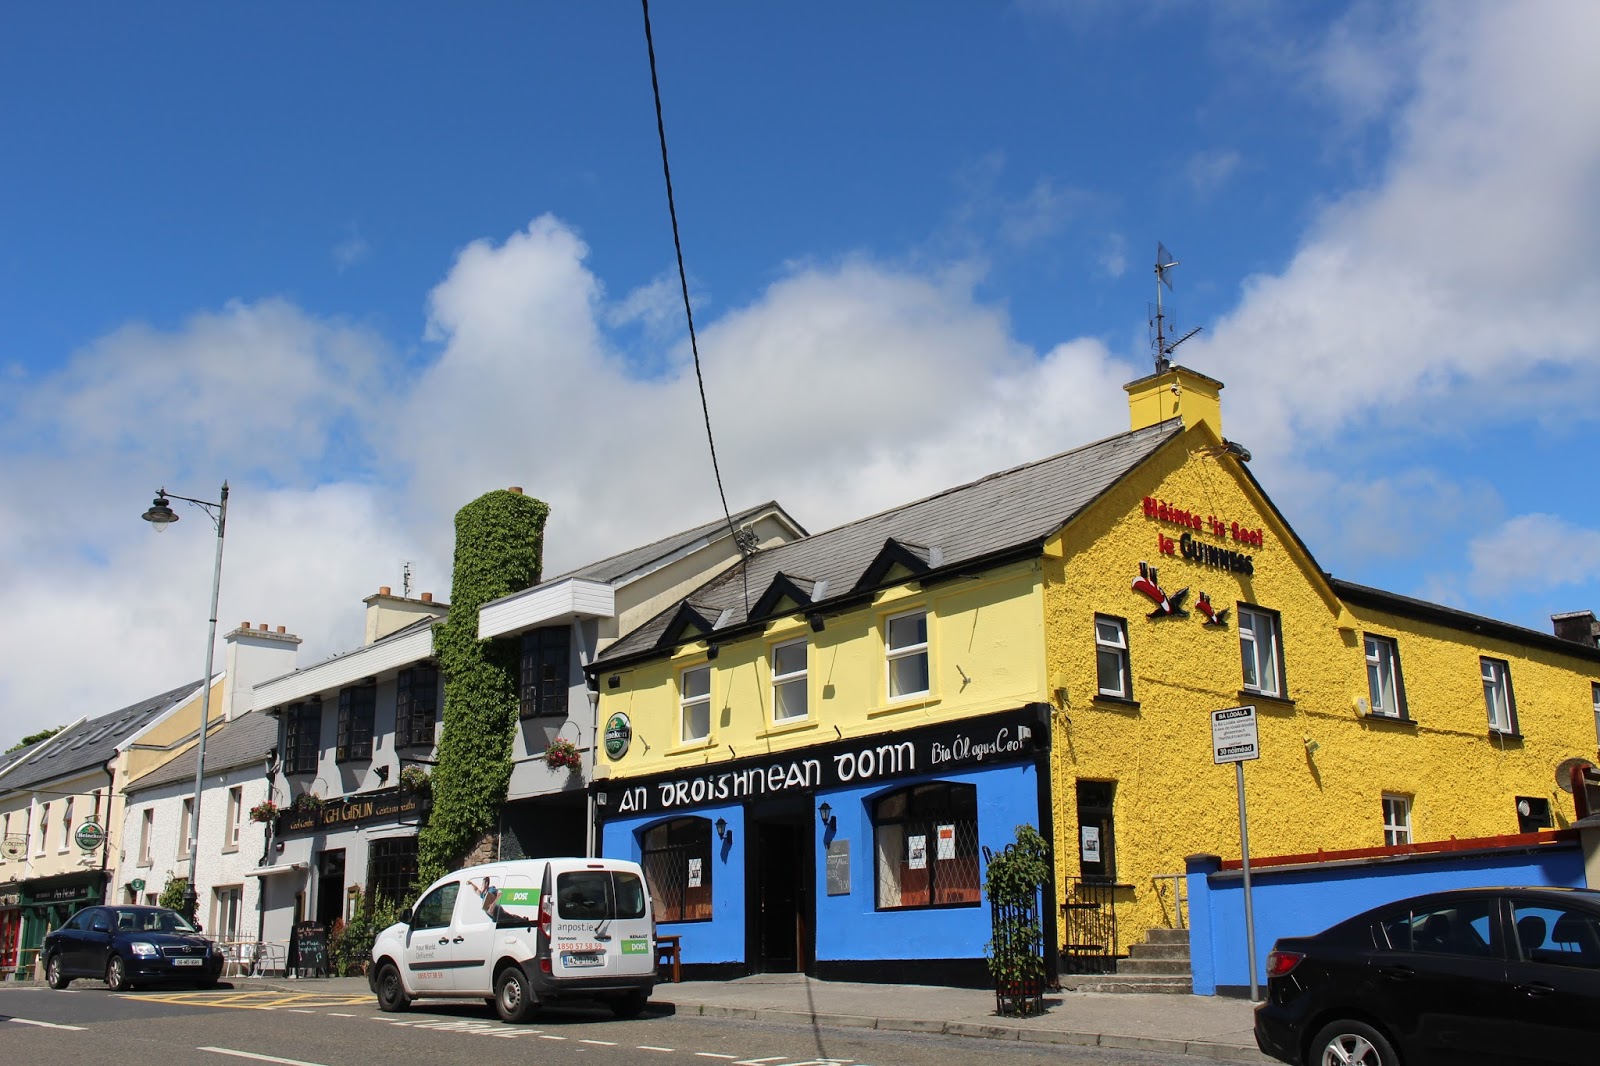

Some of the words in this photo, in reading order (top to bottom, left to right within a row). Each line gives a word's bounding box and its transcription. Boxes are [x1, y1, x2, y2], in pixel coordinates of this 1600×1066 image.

[1158, 532, 1175, 555] le
[1180, 532, 1254, 577] GUINNESS
[931, 742, 952, 764] Bia
[952, 734, 971, 761] Ól
[971, 742, 996, 761] agus
[342, 802, 373, 821] GIBLIN
[557, 923, 594, 934] anpost.ie
